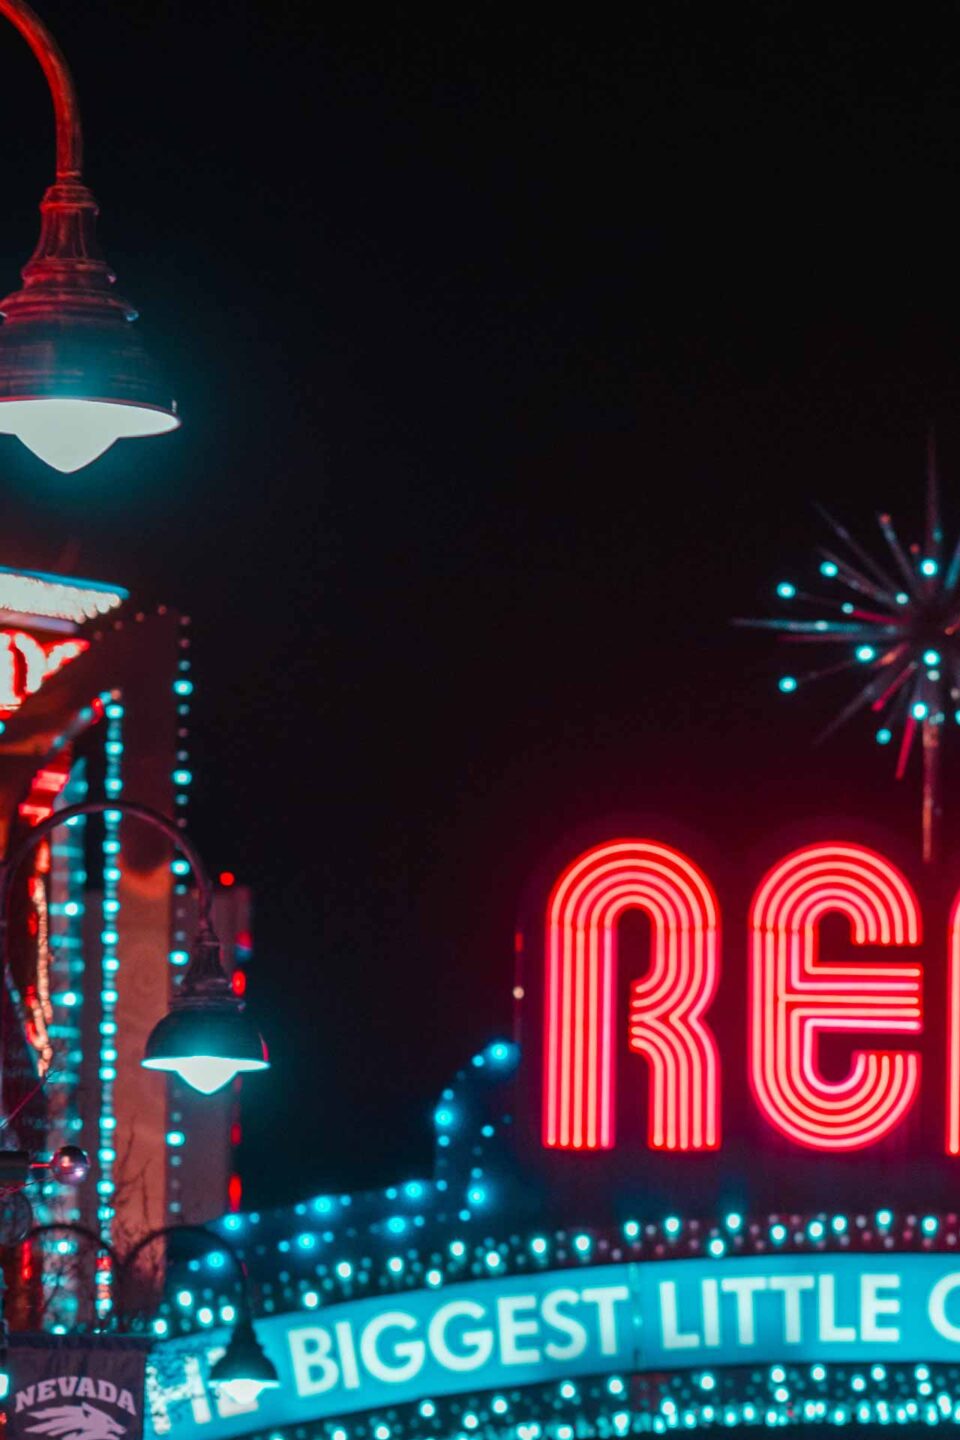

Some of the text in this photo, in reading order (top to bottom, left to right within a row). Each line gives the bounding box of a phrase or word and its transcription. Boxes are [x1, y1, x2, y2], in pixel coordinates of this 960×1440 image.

[287, 1285, 629, 1398] BIGGEST
[659, 1271, 901, 1352] LITTLE
[14, 1376, 137, 1416] NEVADA
